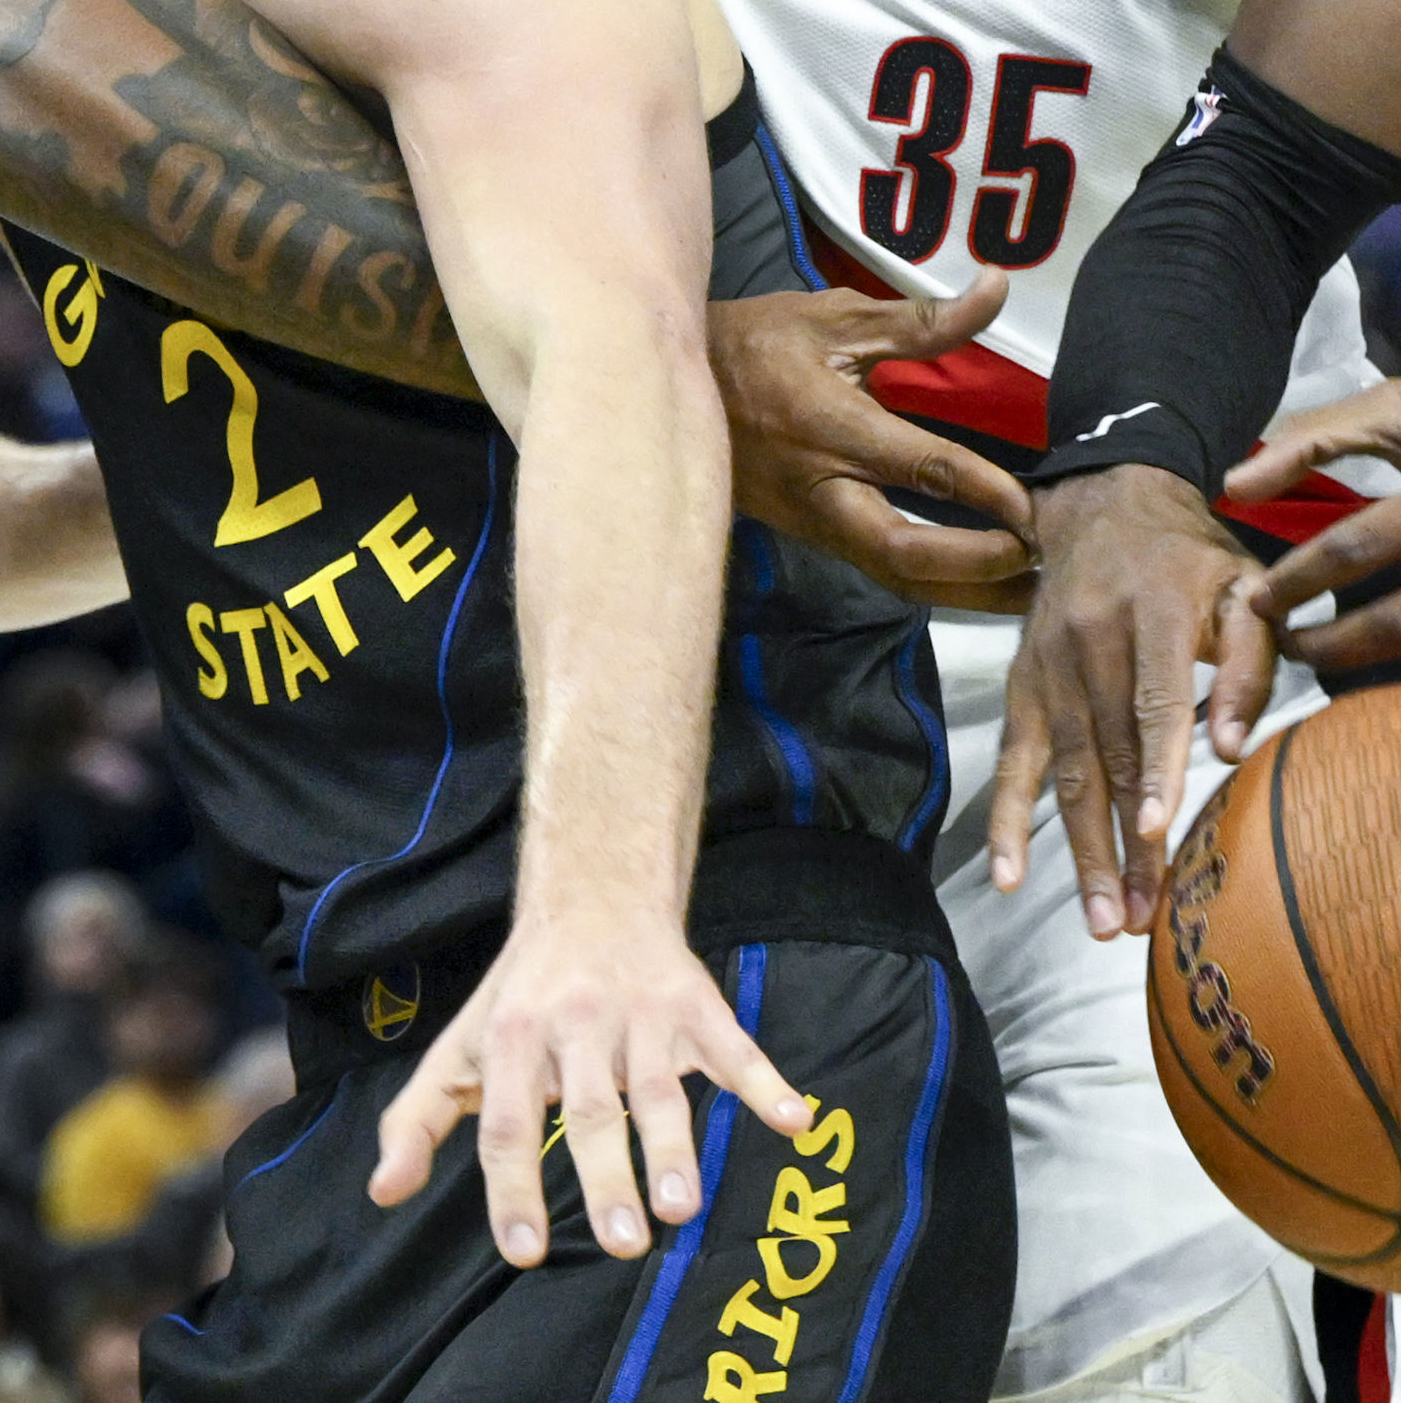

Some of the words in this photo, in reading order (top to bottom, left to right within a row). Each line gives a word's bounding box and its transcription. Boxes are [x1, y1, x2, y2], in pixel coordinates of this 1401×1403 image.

[859, 35, 1092, 270] 35
[161, 320, 323, 547] 2
[186, 494, 456, 705] STATE
